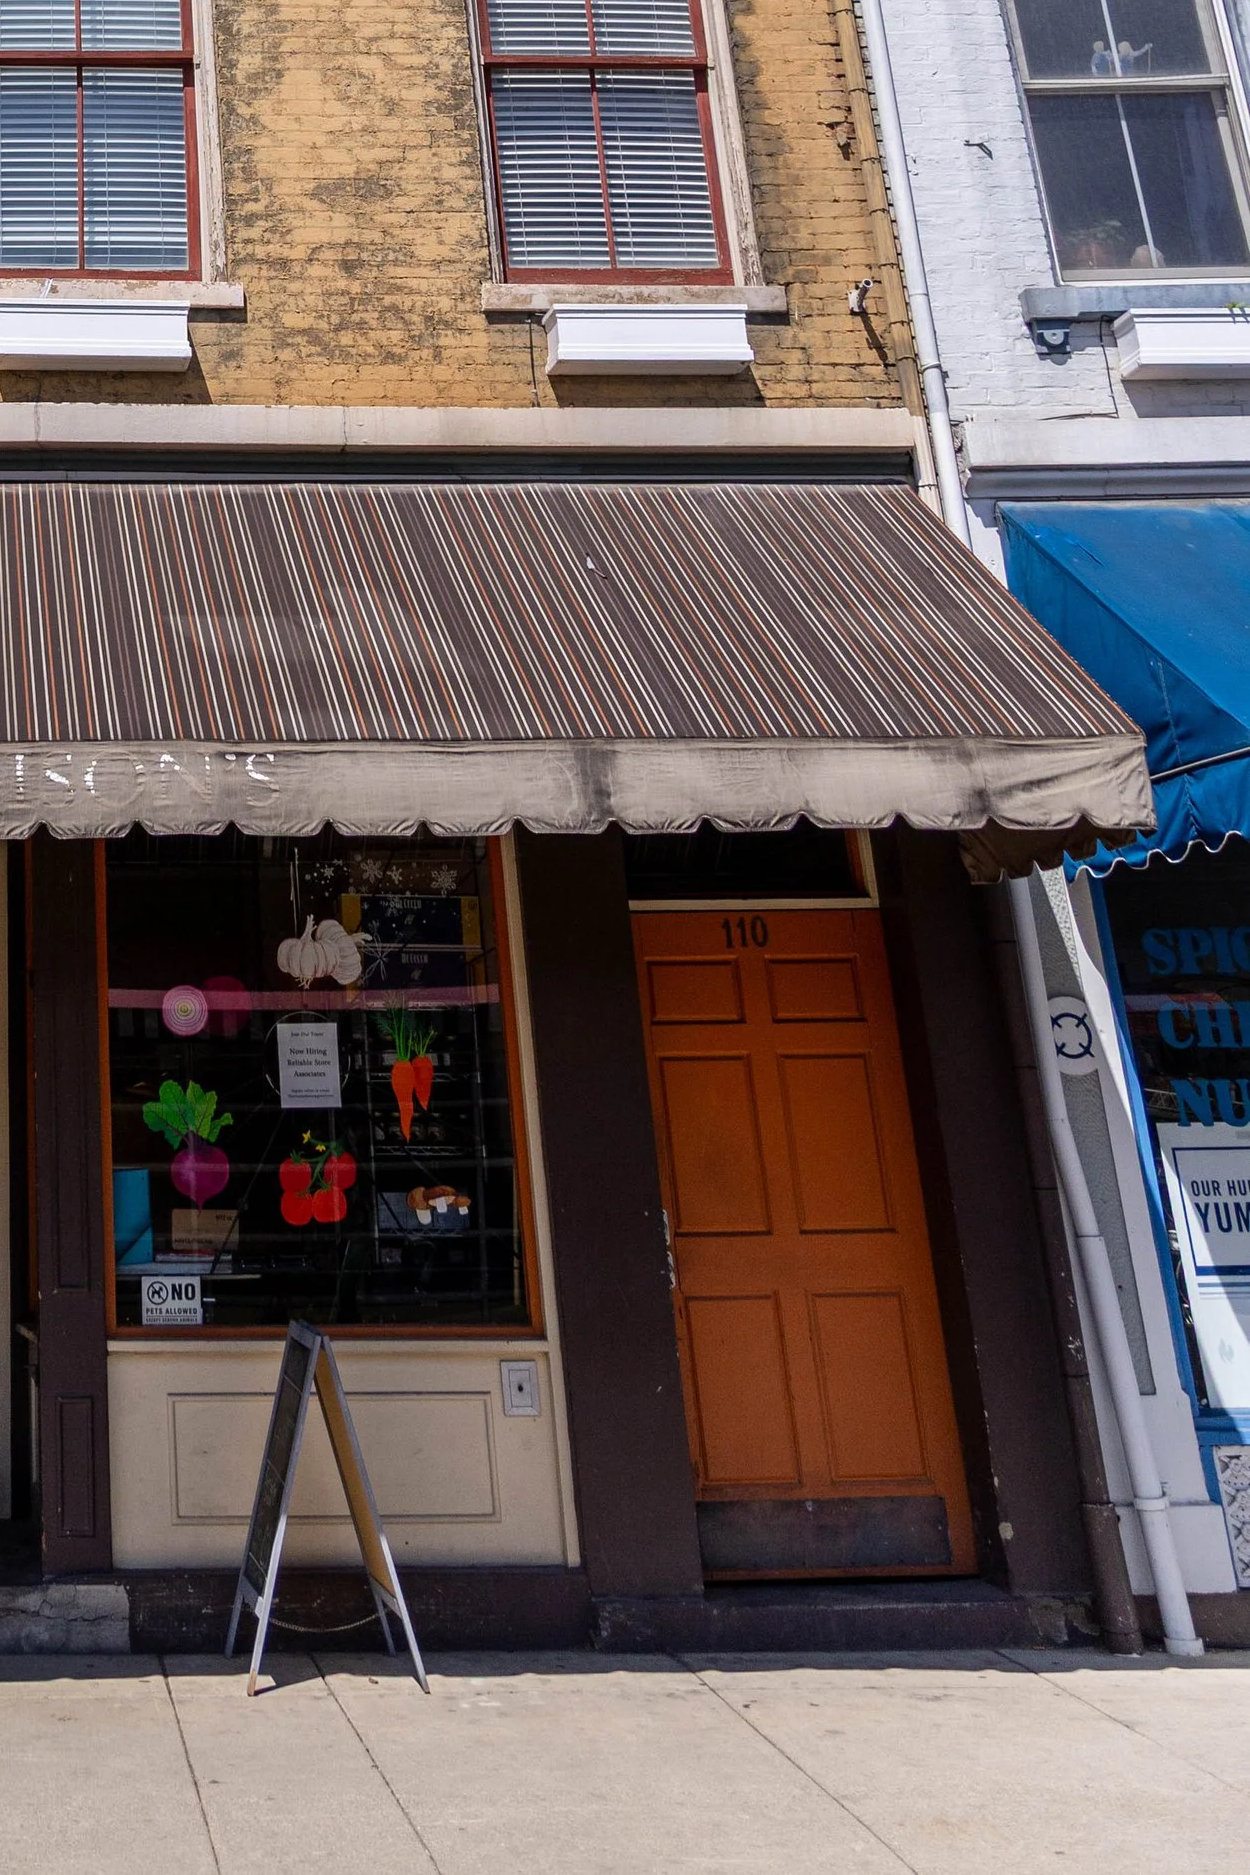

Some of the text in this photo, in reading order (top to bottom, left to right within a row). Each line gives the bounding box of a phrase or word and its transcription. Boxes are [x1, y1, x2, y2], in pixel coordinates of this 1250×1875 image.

[722, 915, 769, 949] 110
[306, 1047, 327, 1056] Hiring
[293, 1070, 326, 1078] Associates
[1191, 1179, 1250, 1197] OUR HU
[170, 1283, 196, 1301] NO
[145, 1307, 198, 1315] PETS ALLOWED
